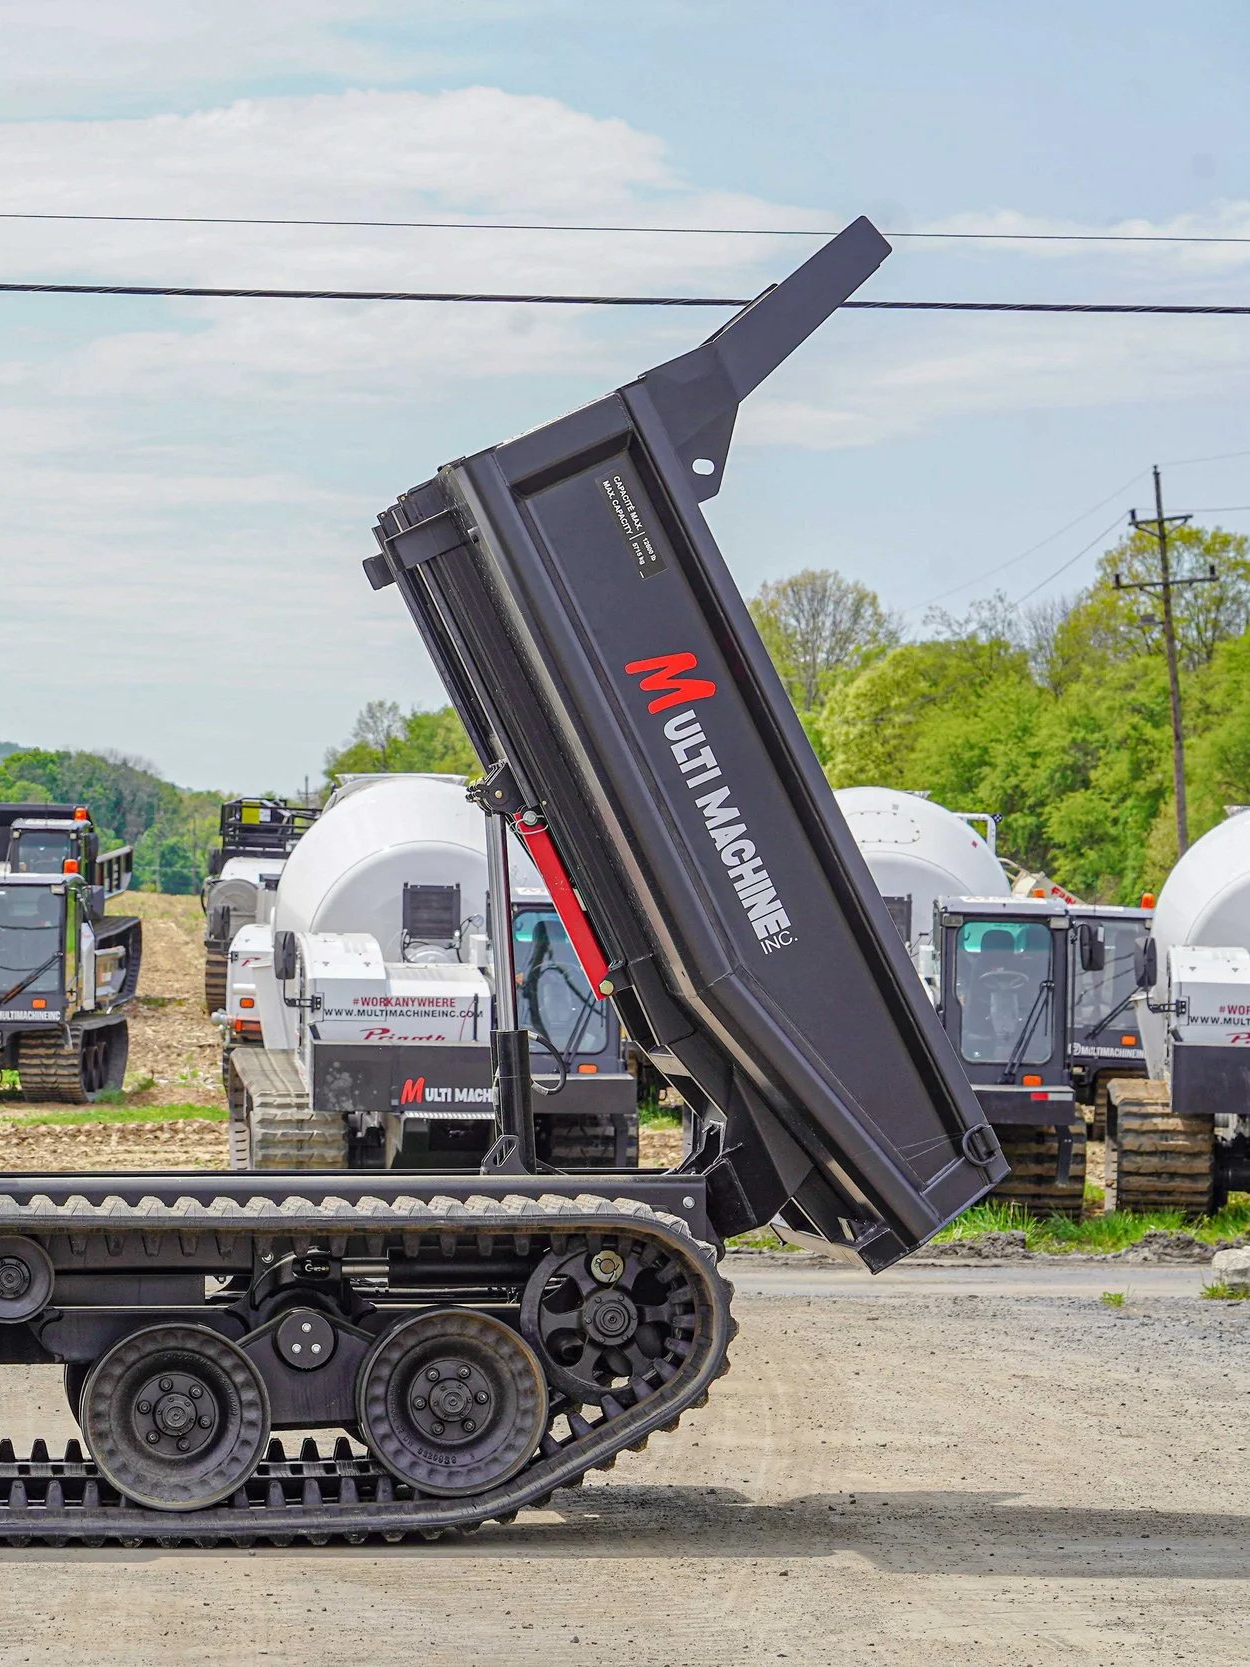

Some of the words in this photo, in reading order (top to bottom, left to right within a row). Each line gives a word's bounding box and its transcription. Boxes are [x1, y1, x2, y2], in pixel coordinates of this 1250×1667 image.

[602, 480, 616, 500] MAX.
[612, 499, 634, 535] CAPACITY
[613, 475, 636, 512] CAPACITÉ
[630, 511, 643, 531] MAX.
[694, 785, 792, 941] MACHINE
[760, 930, 798, 955] INC.
[352, 997, 456, 1008] #WORKANYWHERE
[1081, 1045, 1144, 1059] MULTIMACHINEIN
[400, 1076, 452, 1104] MULTI
[454, 1087, 493, 1103] MACH
